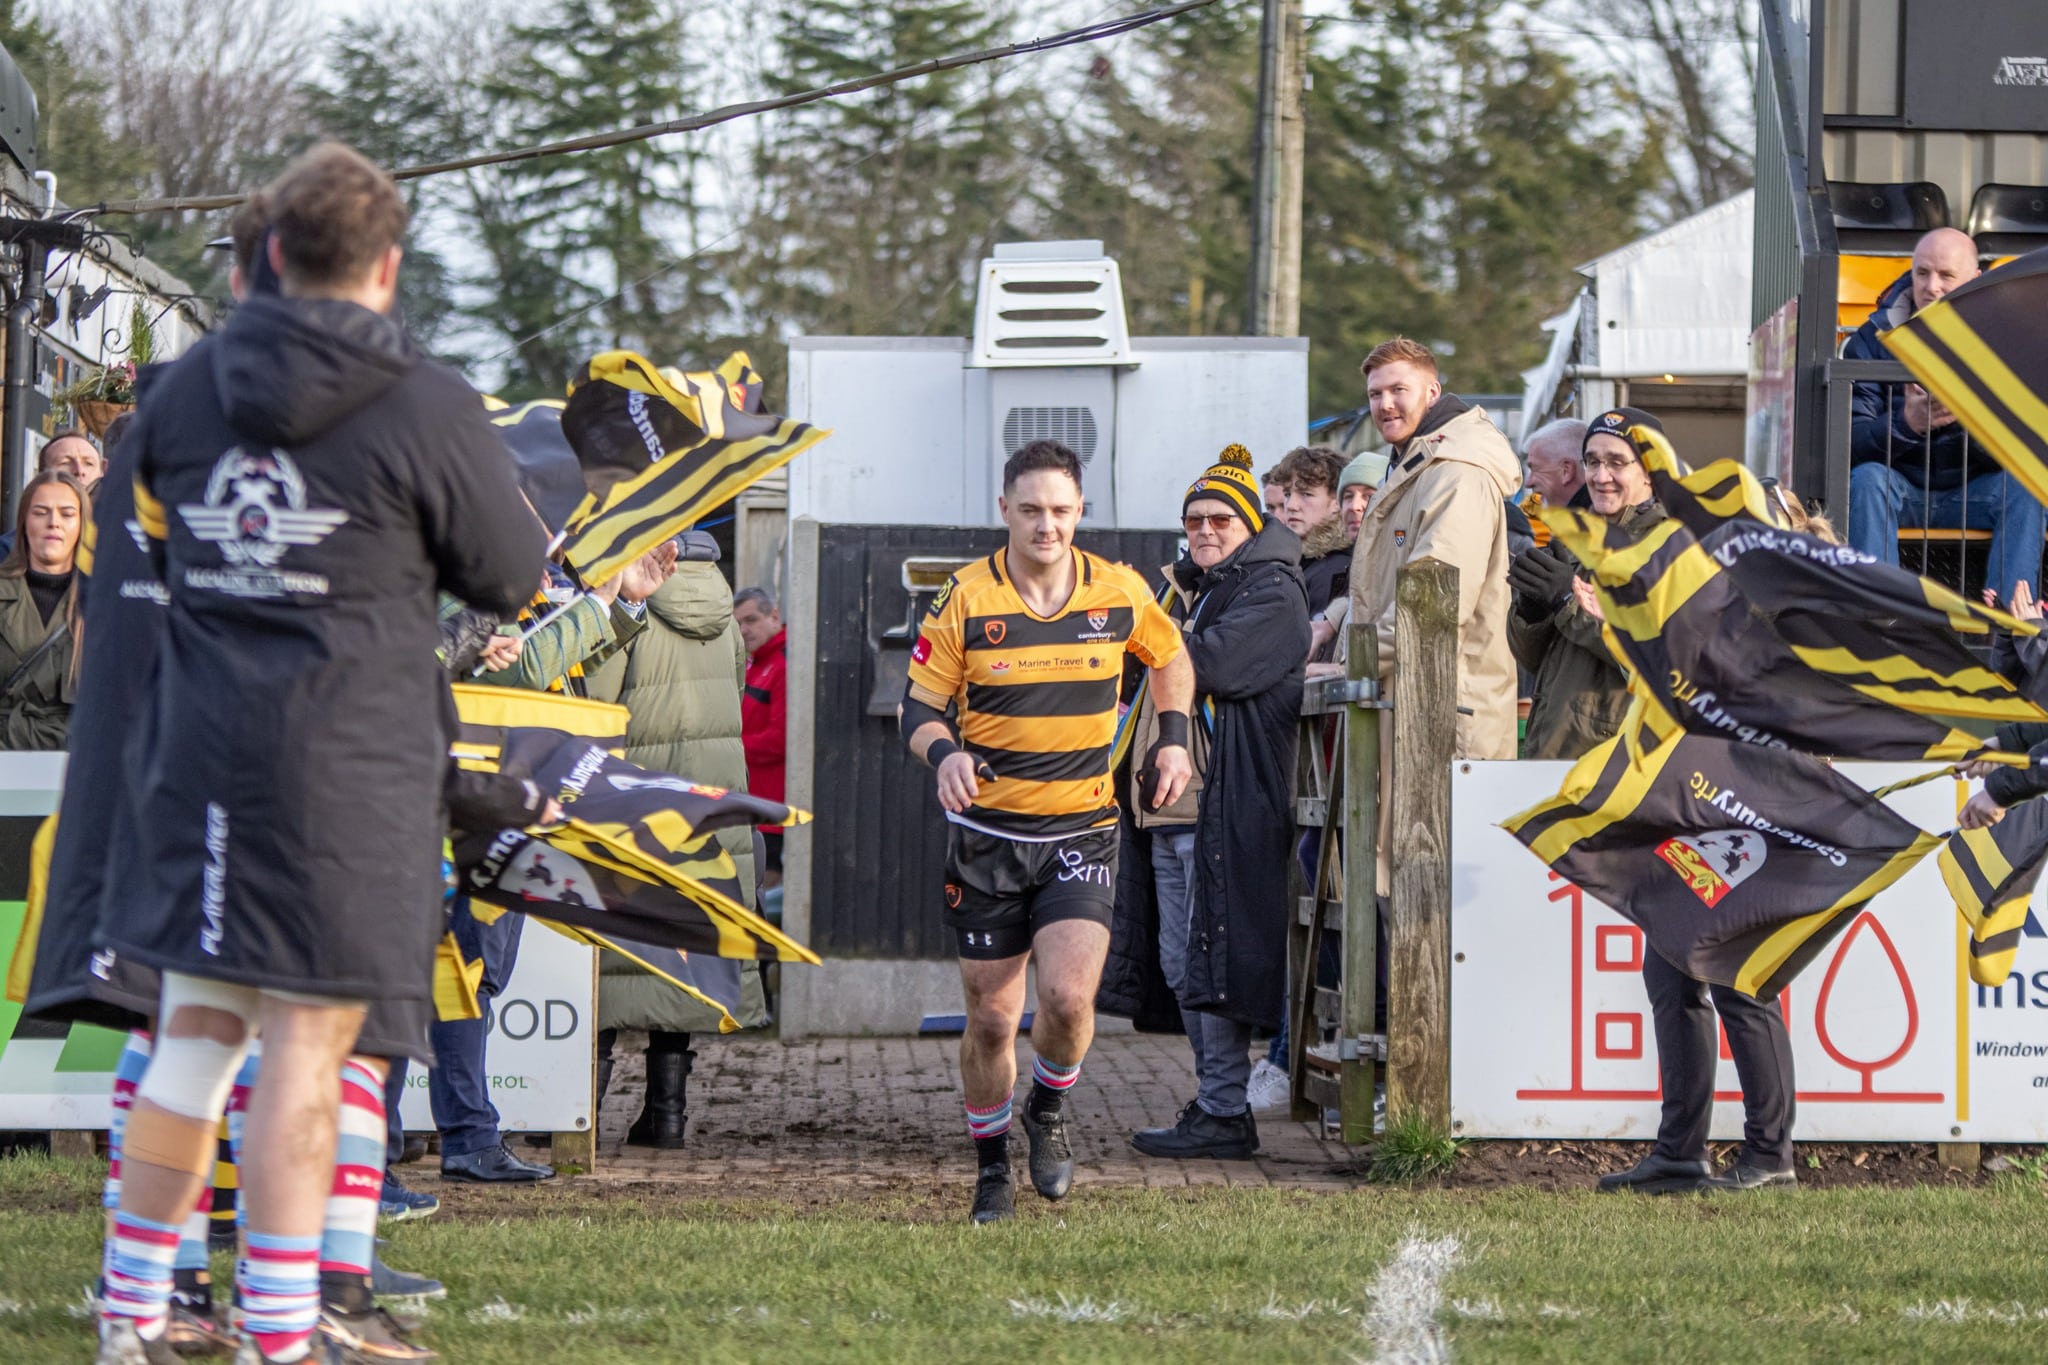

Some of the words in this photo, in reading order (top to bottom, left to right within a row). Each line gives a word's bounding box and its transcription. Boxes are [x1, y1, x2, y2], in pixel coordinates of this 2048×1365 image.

[1018, 659, 1053, 669] Marine
[1053, 657, 1084, 666] Travel
[487, 999, 579, 1041] OD
